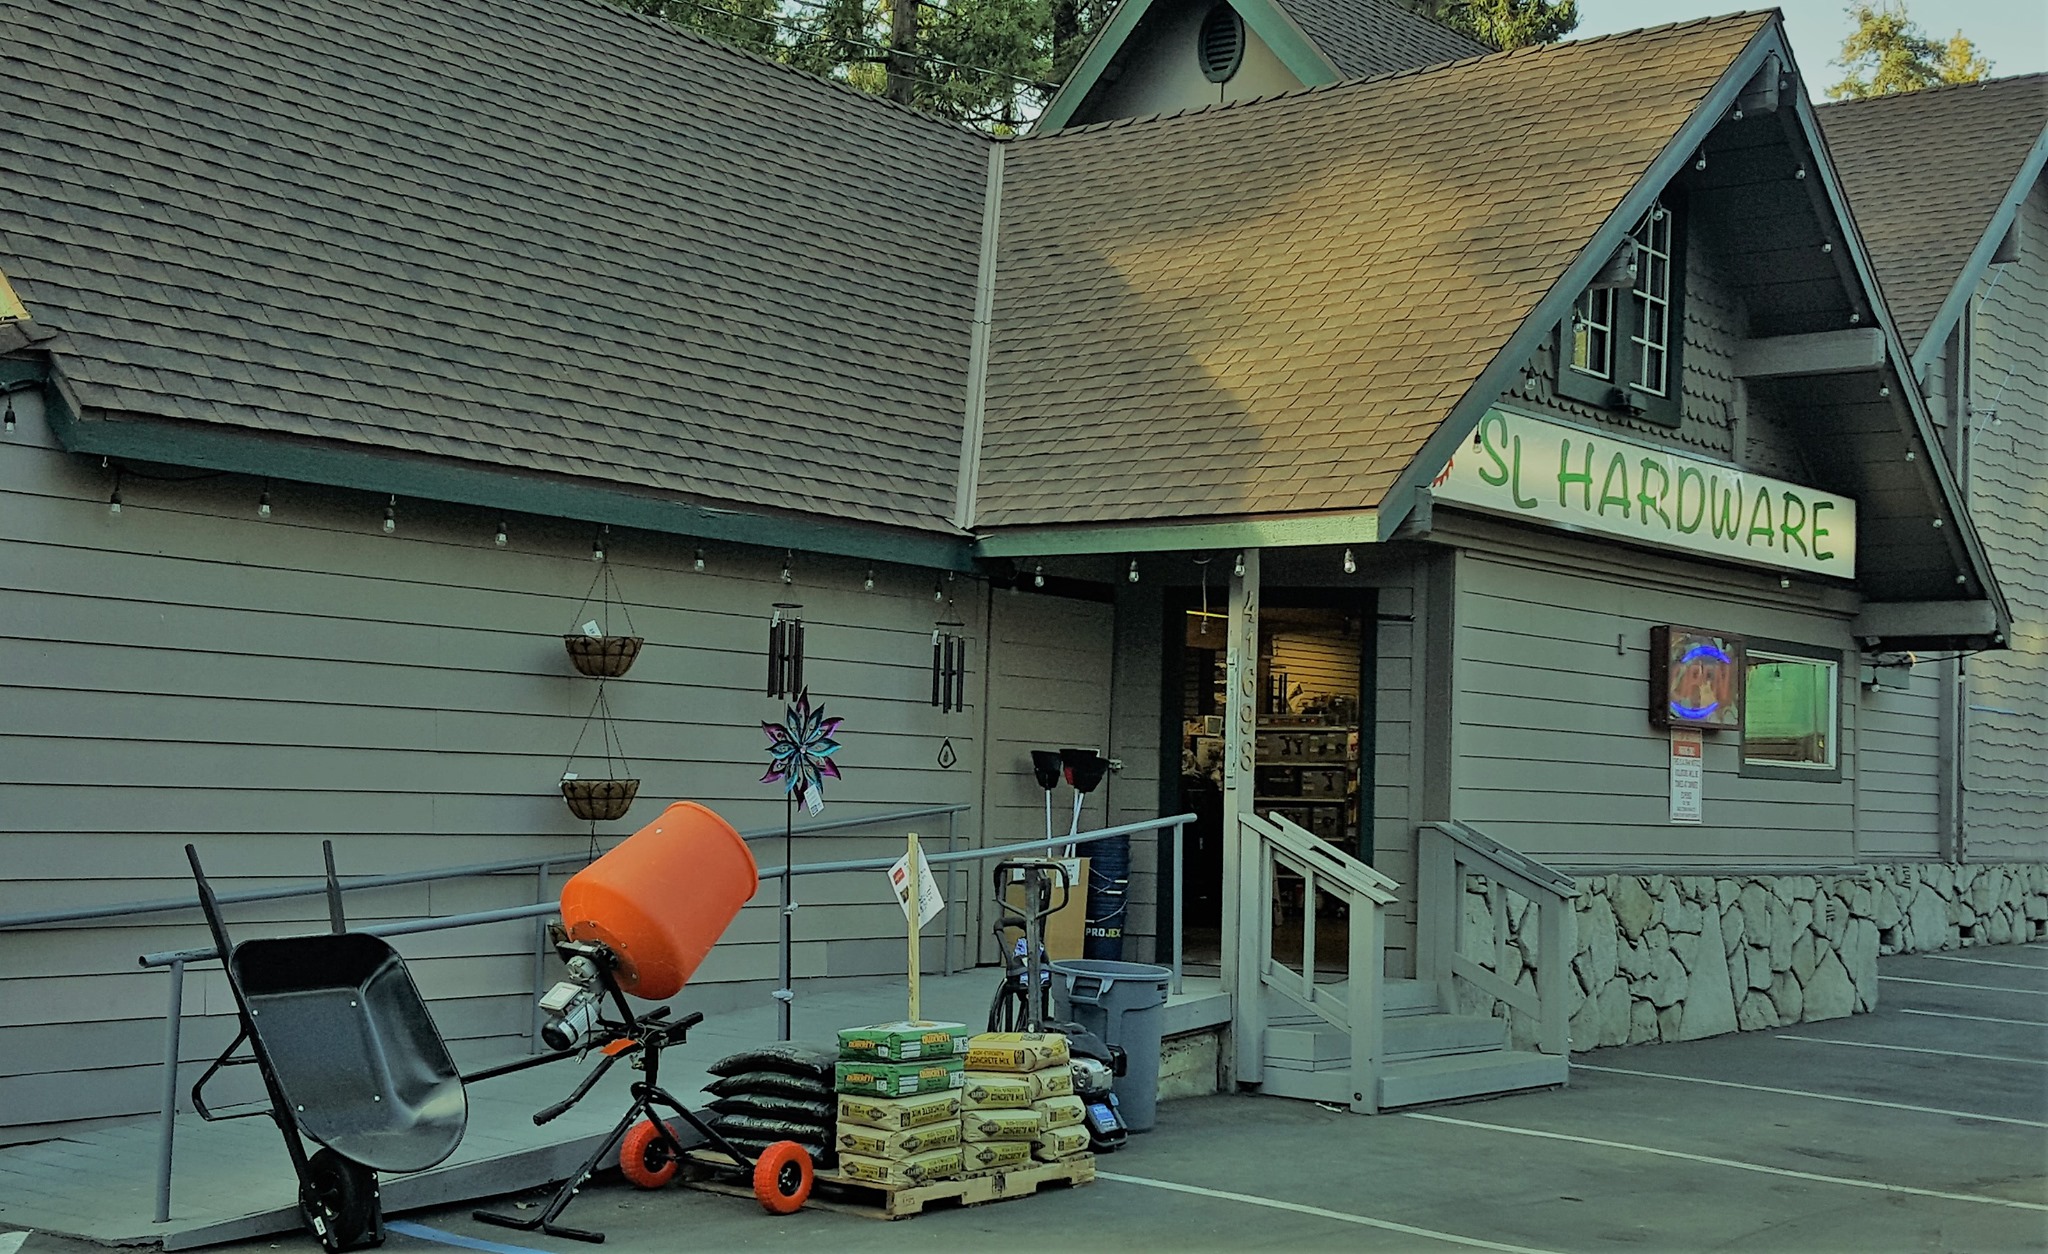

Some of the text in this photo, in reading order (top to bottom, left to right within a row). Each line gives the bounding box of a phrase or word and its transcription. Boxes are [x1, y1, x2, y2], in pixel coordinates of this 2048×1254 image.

[1478, 411, 1835, 561] SL HARDWARE
[1240, 590, 1255, 772] 41698
[1085, 927, 1122, 938] PROJEX
[970, 1056, 1010, 1066] CONCRETE MIX
